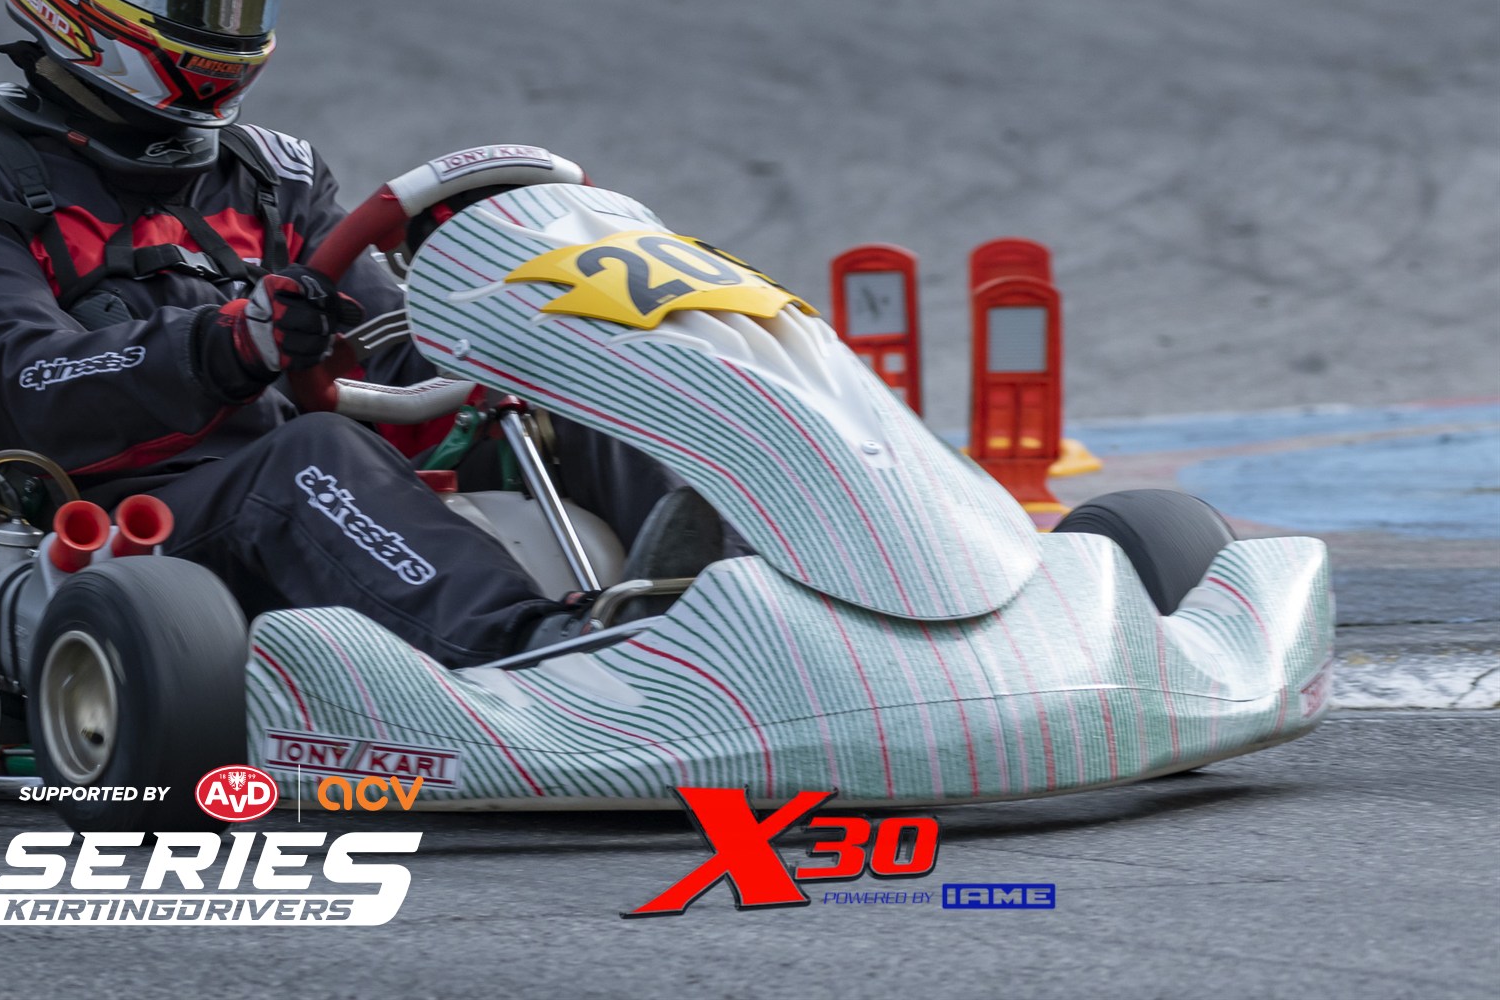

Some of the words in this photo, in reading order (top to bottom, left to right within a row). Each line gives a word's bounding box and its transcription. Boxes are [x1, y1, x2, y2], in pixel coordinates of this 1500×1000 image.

[435, 149, 487, 170] TONY
[295, 465, 437, 586] alpinestars
[268, 734, 349, 767] TONY
[369, 745, 456, 779] KART
